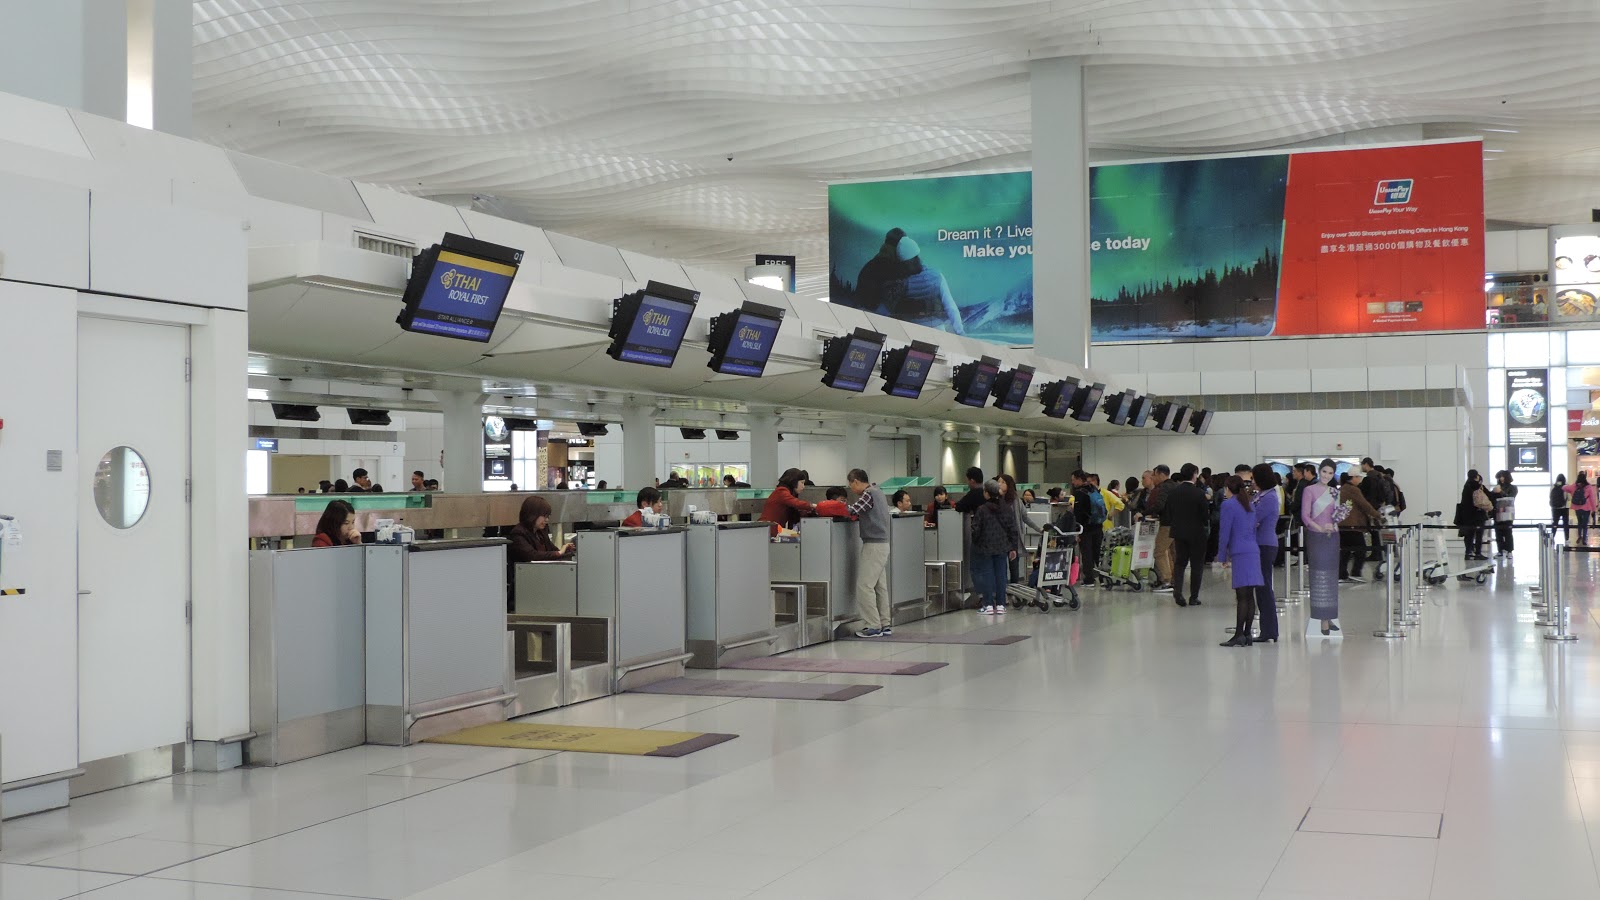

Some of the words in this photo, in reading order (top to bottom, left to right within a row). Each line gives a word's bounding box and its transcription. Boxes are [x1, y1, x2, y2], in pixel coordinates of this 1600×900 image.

[1380, 186, 1409, 195] UnionPay
[938, 228, 979, 241] Dream
[983, 227, 992, 239] it
[995, 226, 1002, 238] ?
[1008, 225, 1032, 237] Live
[963, 244, 1004, 258] Make
[1105, 236, 1151, 251] today
[454, 273, 482, 291] THAI
[448, 289, 471, 302] ROYAL
[470, 295, 489, 305] FIRST
[651, 312, 670, 326] THAI
[647, 326, 661, 336] ROYAL
[746, 326, 761, 340] THAI
[1045, 572, 1063, 580] KOHLER
